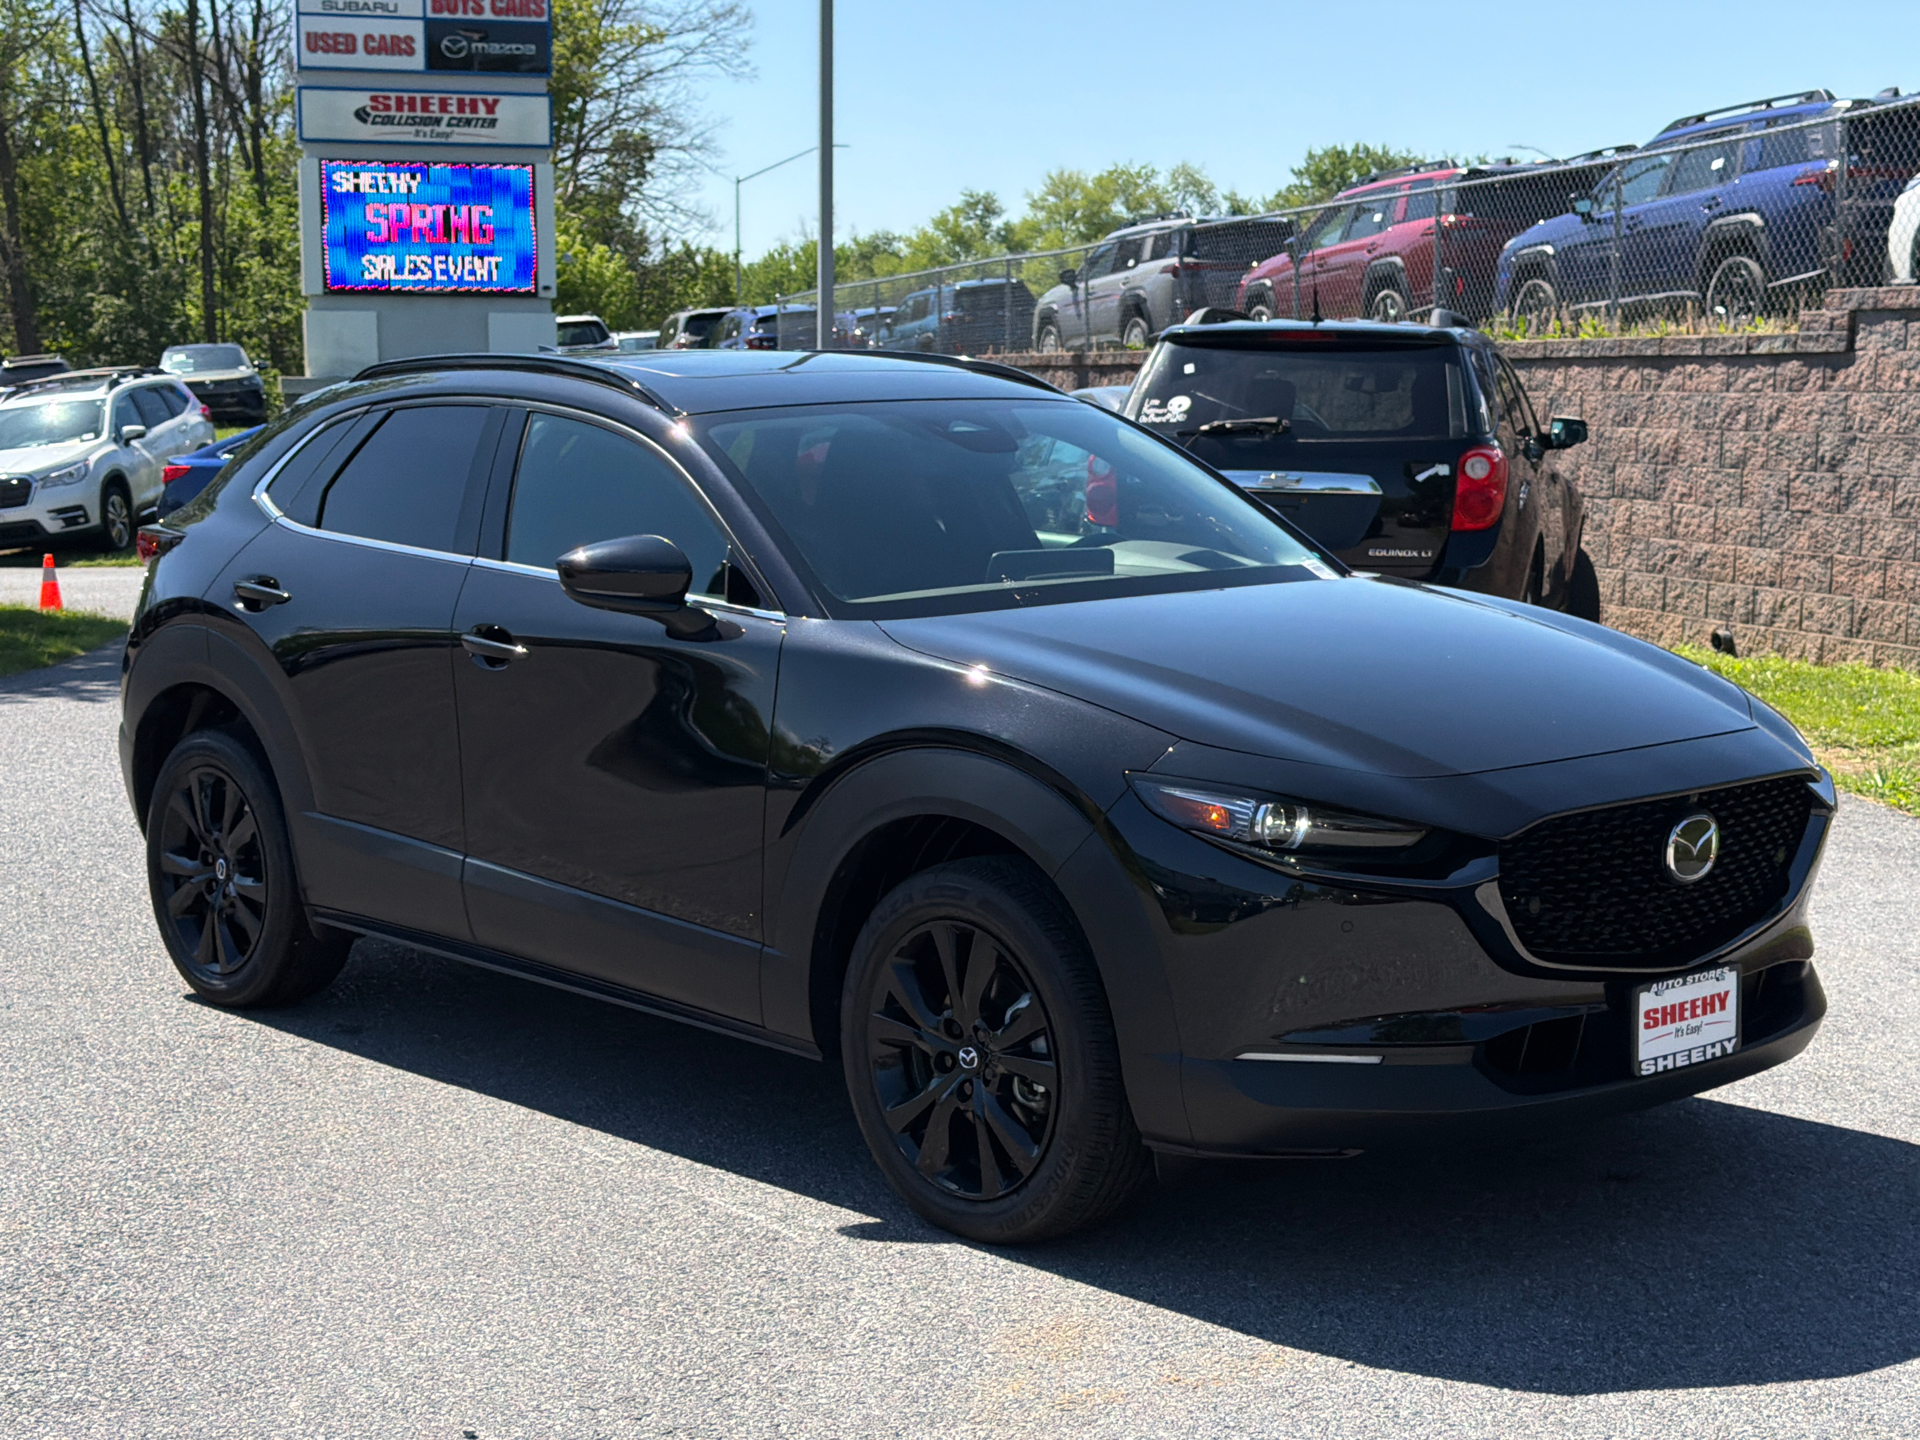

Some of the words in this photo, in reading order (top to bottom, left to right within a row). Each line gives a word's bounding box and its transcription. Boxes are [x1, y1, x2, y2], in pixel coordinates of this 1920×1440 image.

[321, 1, 399, 13] SUBARU
[490, 0, 546, 18] CARS
[305, 31, 357, 55] USED
[363, 33, 416, 57] CARS
[369, 94, 500, 115] SHEEHY
[370, 114, 444, 127] COLLISION
[446, 116, 499, 129] CENTER
[332, 171, 421, 194] SHEEHY
[365, 203, 494, 244] SPRING
[361, 254, 431, 281] SALES
[434, 255, 503, 282] EVENT
[1368, 548, 1418, 557] EQUINOX
[1421, 549, 1432, 557] LT
[1650, 978, 1683, 994] AUTO
[1686, 966, 1730, 985] STORES
[1643, 990, 1731, 1030] SHEEHY
[1674, 1025, 1685, 1039] It's
[1686, 1021, 1704, 1036] Easy!
[1640, 1038, 1738, 1076] SHEEHY
